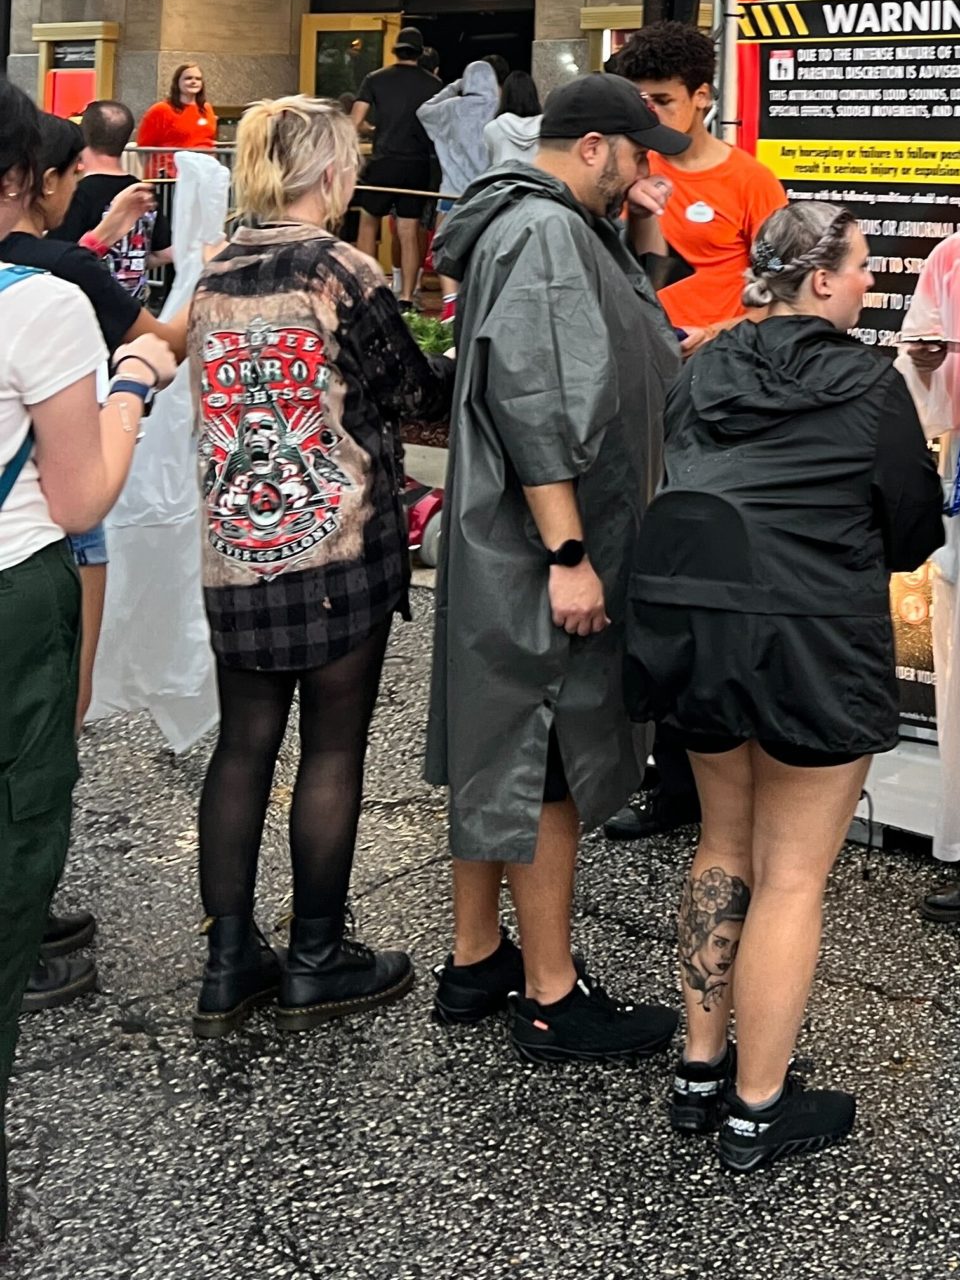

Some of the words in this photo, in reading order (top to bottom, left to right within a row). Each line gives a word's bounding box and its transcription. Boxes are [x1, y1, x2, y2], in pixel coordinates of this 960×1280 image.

[797, 48, 817, 62] DUE
[818, 48, 832, 62] TO
[833, 48, 852, 61] THE
[937, 46, 952, 60] OF
[906, 66, 917, 79] IS
[847, 149, 857, 158] or
[894, 147, 903, 158] to
[906, 147, 937, 159] follow
[822, 162, 831, 173] in
[901, 167, 911, 175] or
[280, 519, 337, 558] ALONE
